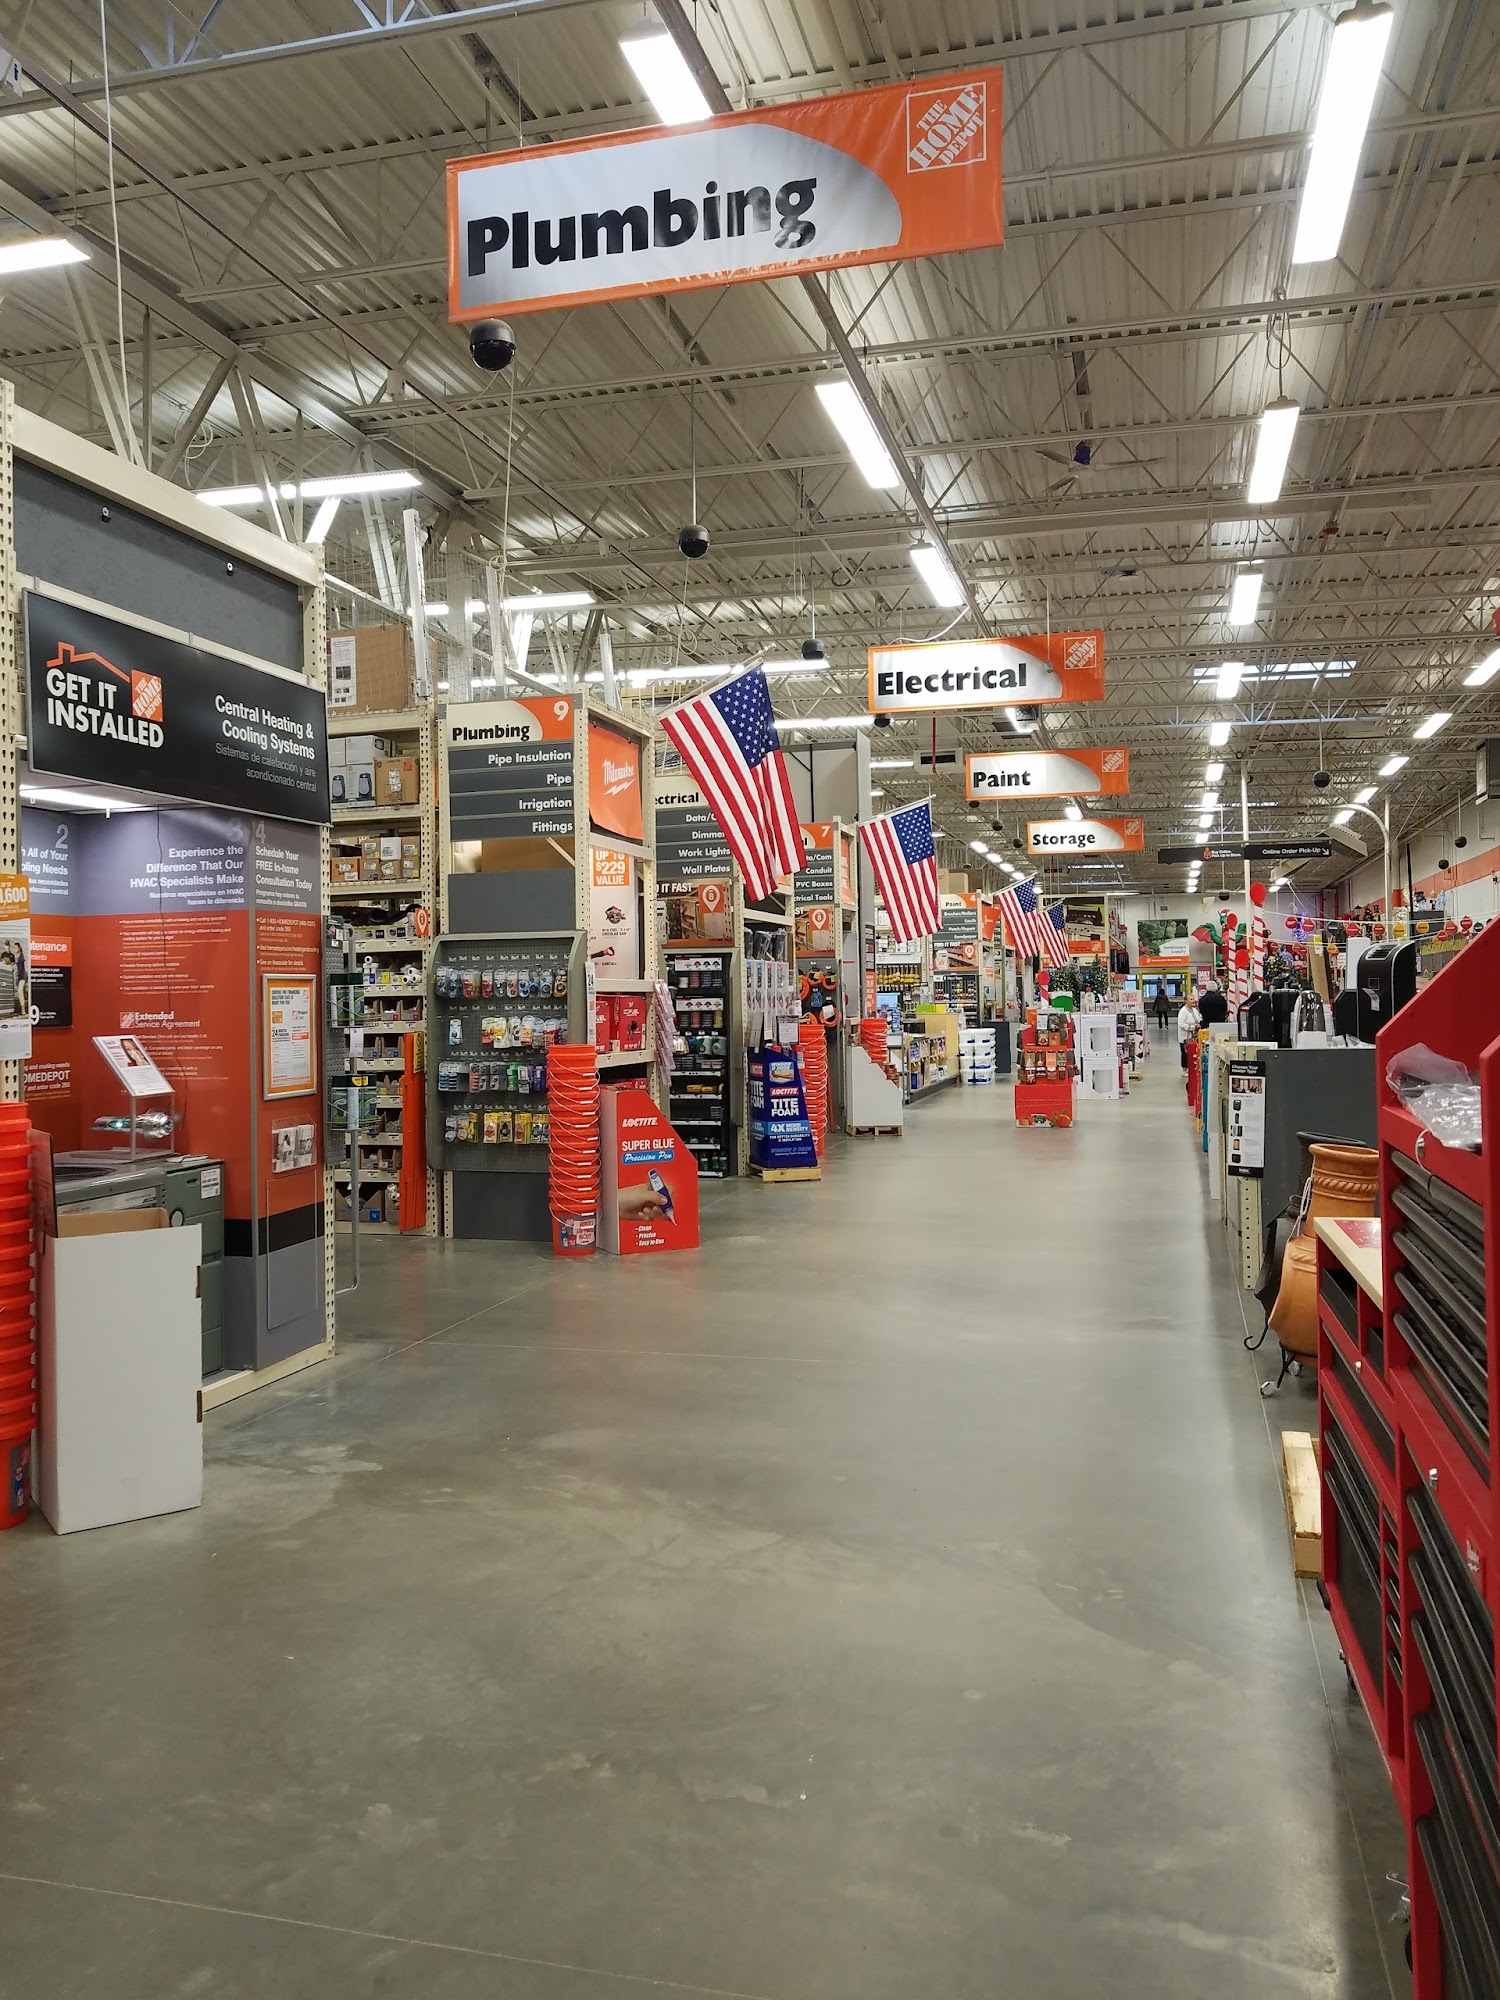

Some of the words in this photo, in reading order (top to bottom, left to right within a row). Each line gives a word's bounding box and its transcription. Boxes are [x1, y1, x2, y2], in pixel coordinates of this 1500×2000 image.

[916, 99, 946, 132] THE
[908, 84, 987, 170] HOME
[938, 113, 985, 166] DEPOT
[467, 177, 817, 277] Plumbing
[1065, 636, 1096, 669] HOME
[878, 663, 1027, 696] Electrical
[46, 669, 92, 703] GET
[98, 682, 117, 710] IT
[215, 694, 260, 723] Central
[262, 707, 303, 738] Heating
[305, 722, 314, 739] &
[553, 700, 569, 721] 9
[47, 698, 164, 748] INSTALLED
[222, 719, 267, 750] Cooling
[270, 731, 315, 761] Systems
[452, 724, 530, 742] Plumbing
[215, 742, 250, 762] Sistemas
[251, 750, 260, 763] de
[304, 765, 316, 777] aire
[488, 755, 513, 767] Pipe
[515, 750, 571, 764] Insulation
[602, 759, 635, 785] Milwaukee
[973, 770, 1031, 788] Paint
[246, 767, 295, 788] acondicionado
[296, 777, 317, 792] central
[547, 773, 572, 786] Pipe
[519, 798, 572, 812] Irrigation
[256, 821, 266, 844] 4
[532, 821, 573, 834] Fittings
[821, 826, 830, 838] 7
[55, 824, 69, 849] 2
[1033, 833, 1096, 849] Storage
[27, 847, 38, 858] All
[40, 849, 48, 859] of
[50, 849, 68, 861] Your
[169, 847, 224, 859] Experience
[226, 846, 244, 855] the
[255, 845, 285, 859] Schedule
[285, 850, 299, 861] Your
[678, 848, 703, 858] Work
[705, 847, 731, 858] Lights
[43, 863, 68, 876] Needs
[146, 861, 197, 874] Difference
[200, 861, 222, 871] That
[224, 860, 244, 870] Our
[256, 860, 273, 871] FREE
[274, 862, 299, 874] In-home
[596, 861, 625, 875] $229
[682, 866, 702, 875] Wall
[704, 864, 731, 874] Plates
[805, 866, 832, 874] Conduit
[130, 877, 157, 888] HVAC
[159, 874, 214, 887] Specialists
[216, 874, 244, 884] Make
[256, 875, 294, 888] Consultation
[295, 879, 313, 891] Today
[596, 875, 625, 886] VALUE
[812, 880, 833, 888] Boxes
[226, 888, 244, 896] HVAC
[662, 883, 670, 893] IT
[671, 883, 692, 893] FAST
[815, 894, 833, 902] Tools
[135, 1011, 175, 1021] Extended
[135, 1020, 160, 1029] Service
[161, 1019, 200, 1030] Agreement
[771, 1087, 798, 1096] LOCTITE
[771, 1098, 798, 1108] TITE
[771, 1108, 799, 1117] FOAM
[622, 1117, 658, 1128] LOCTITE
[771, 1124, 785, 1133] 4X
[622, 1139, 651, 1152] SUPER
[653, 1137, 675, 1150] GLUE
[624, 1153, 656, 1163] Precision
[658, 1151, 673, 1161] Pen
